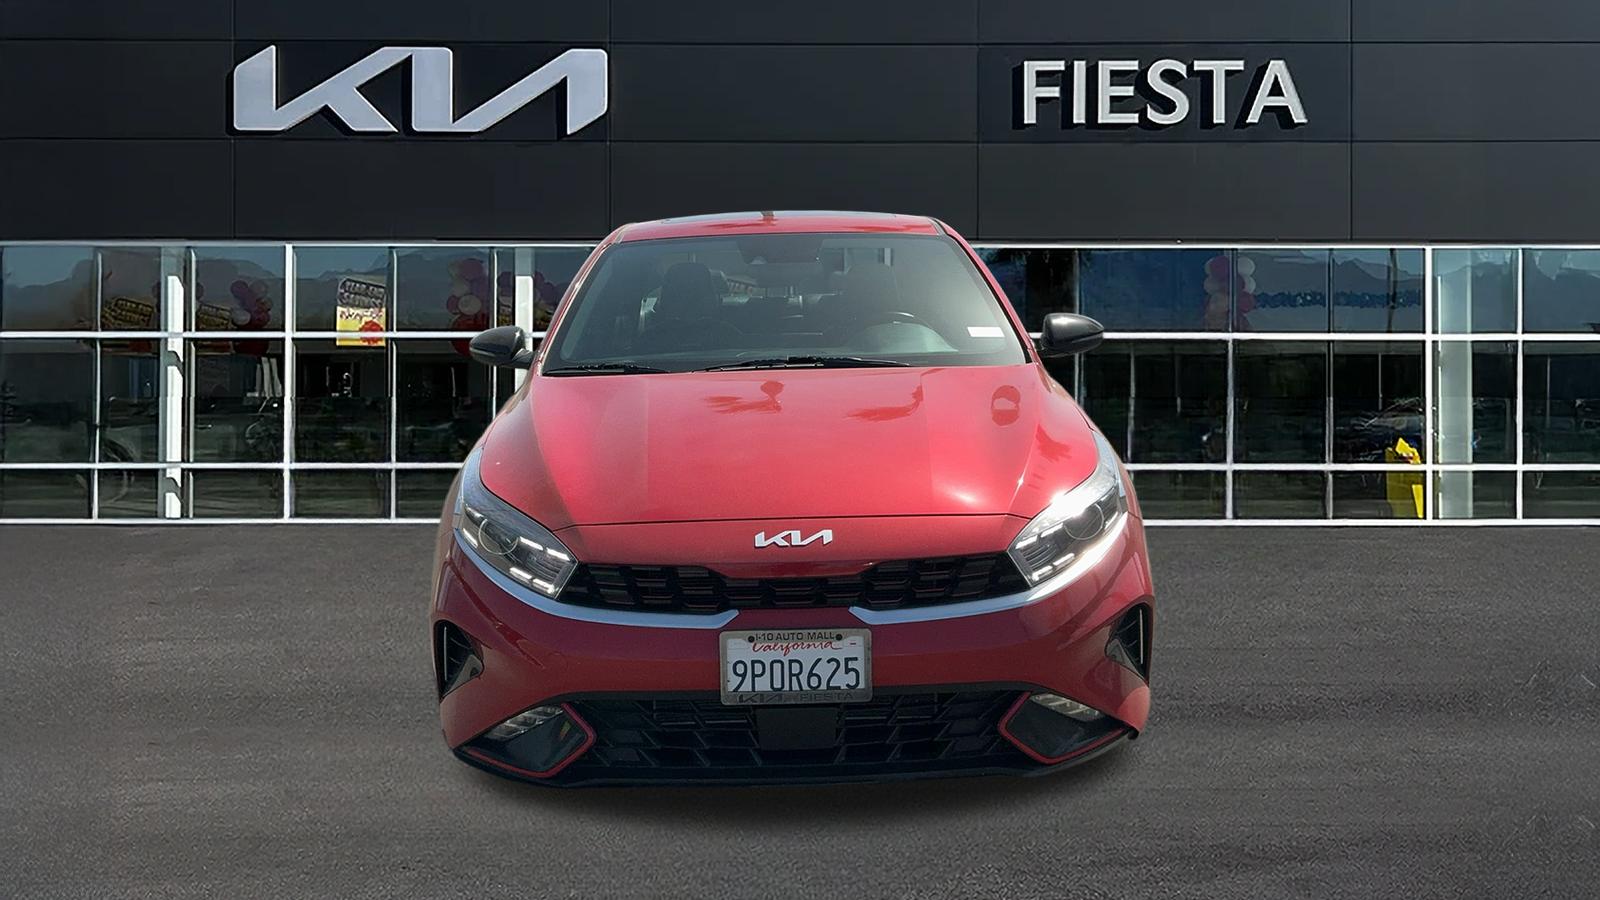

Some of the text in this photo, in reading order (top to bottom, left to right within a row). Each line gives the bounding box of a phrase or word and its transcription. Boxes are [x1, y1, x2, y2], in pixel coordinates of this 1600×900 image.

[233, 44, 608, 135] KIA
[1022, 58, 1308, 125] FIESTA
[754, 529, 833, 547] KIA
[755, 631, 835, 641] I-10 AUTO MALL
[799, 691, 854, 702] FIESTA
